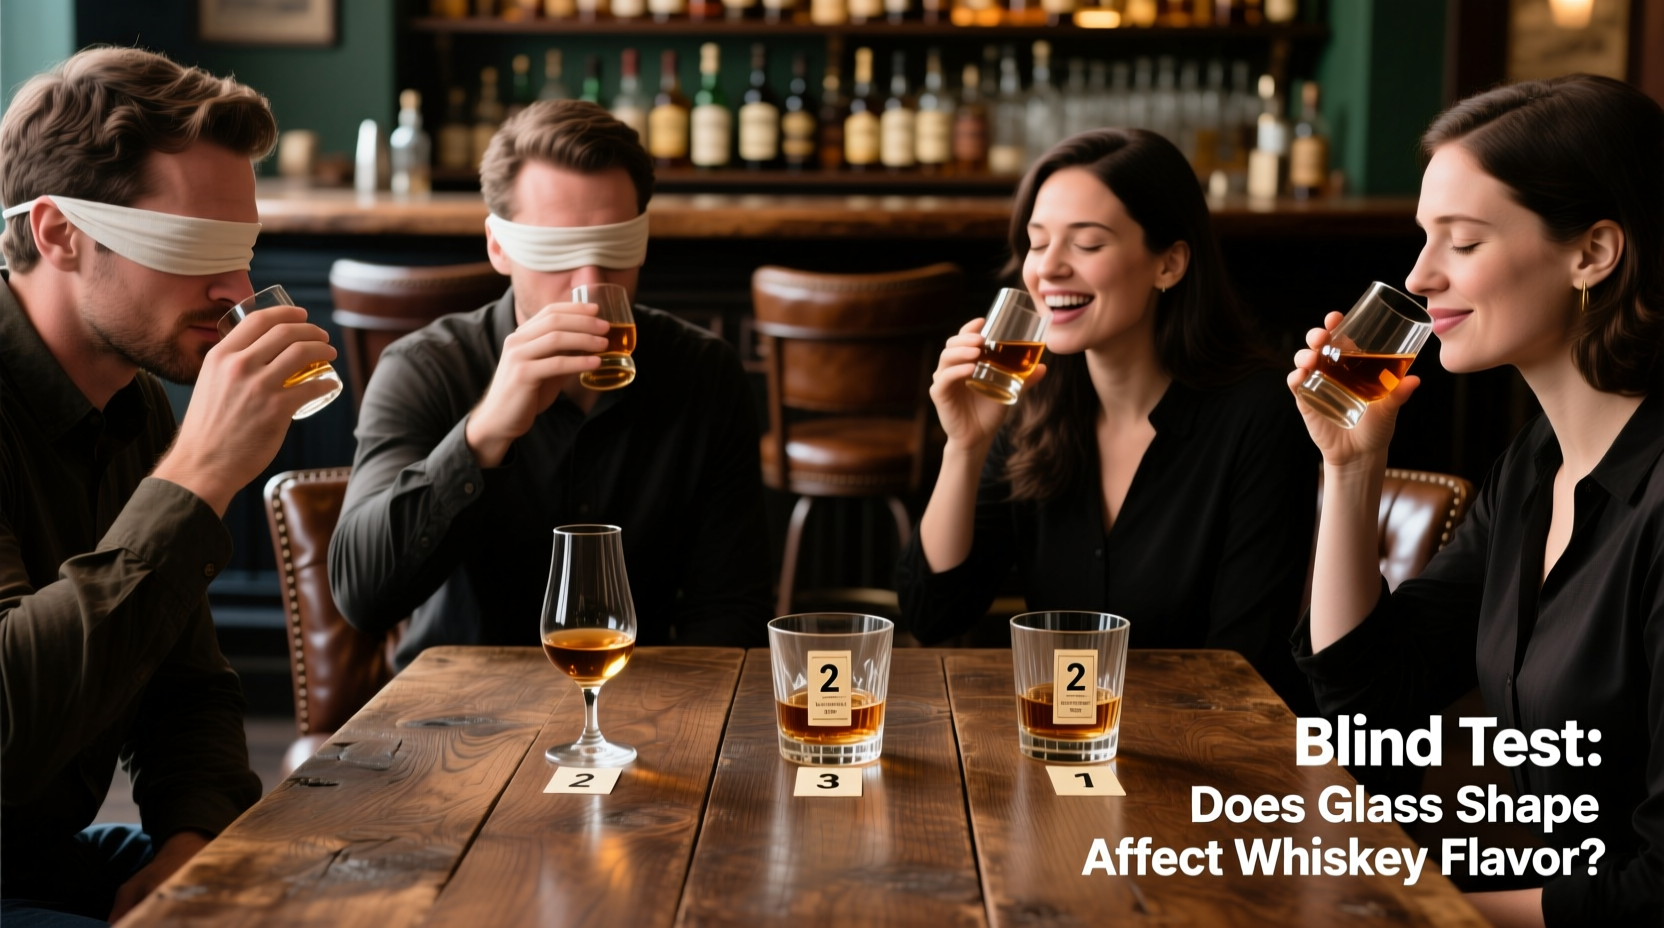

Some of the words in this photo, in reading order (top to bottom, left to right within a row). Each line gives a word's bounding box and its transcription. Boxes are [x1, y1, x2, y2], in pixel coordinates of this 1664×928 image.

[820, 663, 840, 693] 2
[1066, 662, 1086, 691] 2
[568, 773, 595, 788] 2
[816, 773, 840, 789] 3
